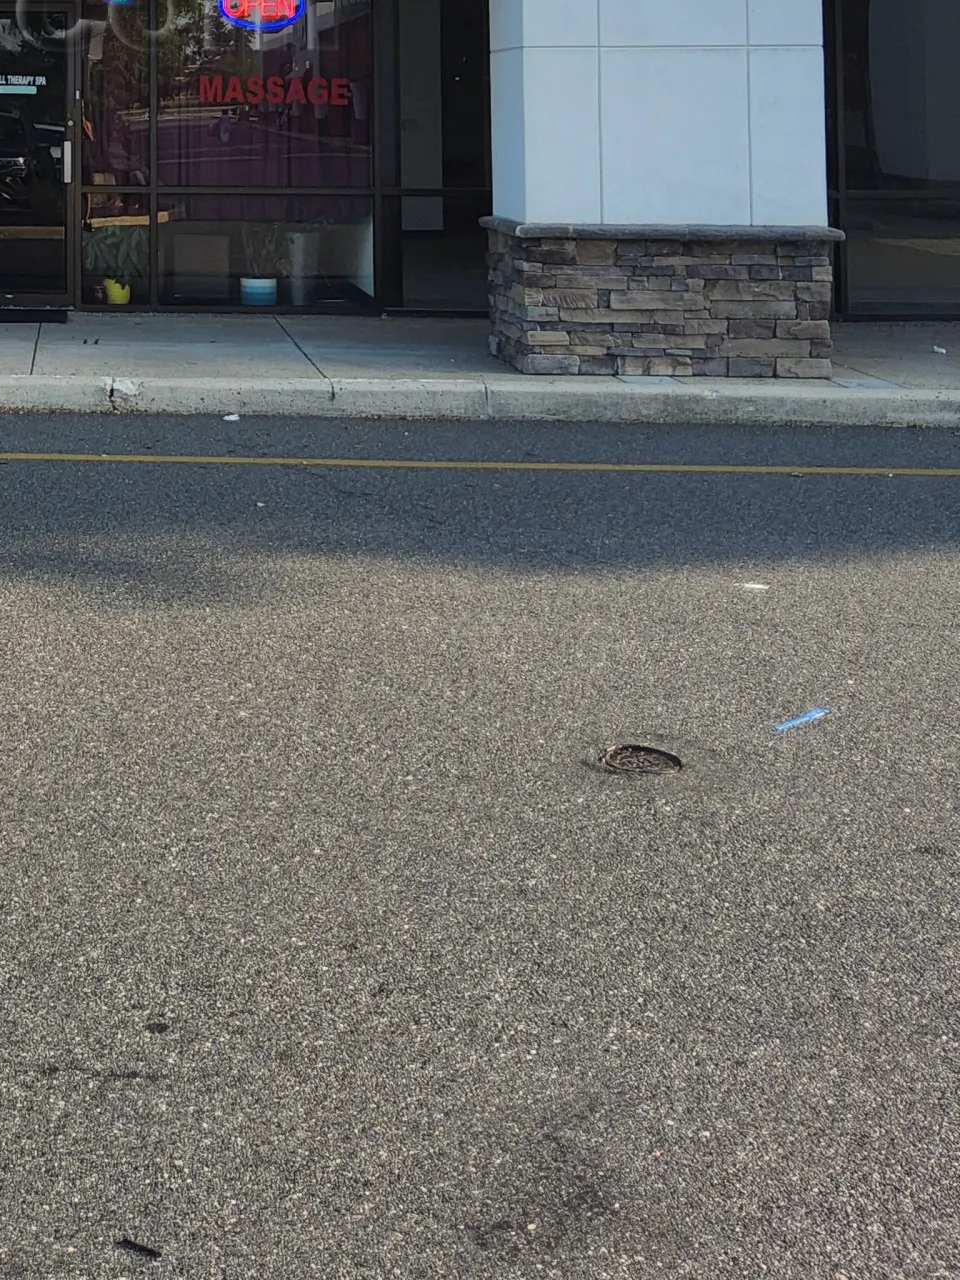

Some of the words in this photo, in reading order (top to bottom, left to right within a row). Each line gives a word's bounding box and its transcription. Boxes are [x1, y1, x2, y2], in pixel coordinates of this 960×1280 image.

[7, 75, 34, 85] THERAPY
[35, 76, 47, 85] SPA
[199, 74, 350, 106] MASSAGE
